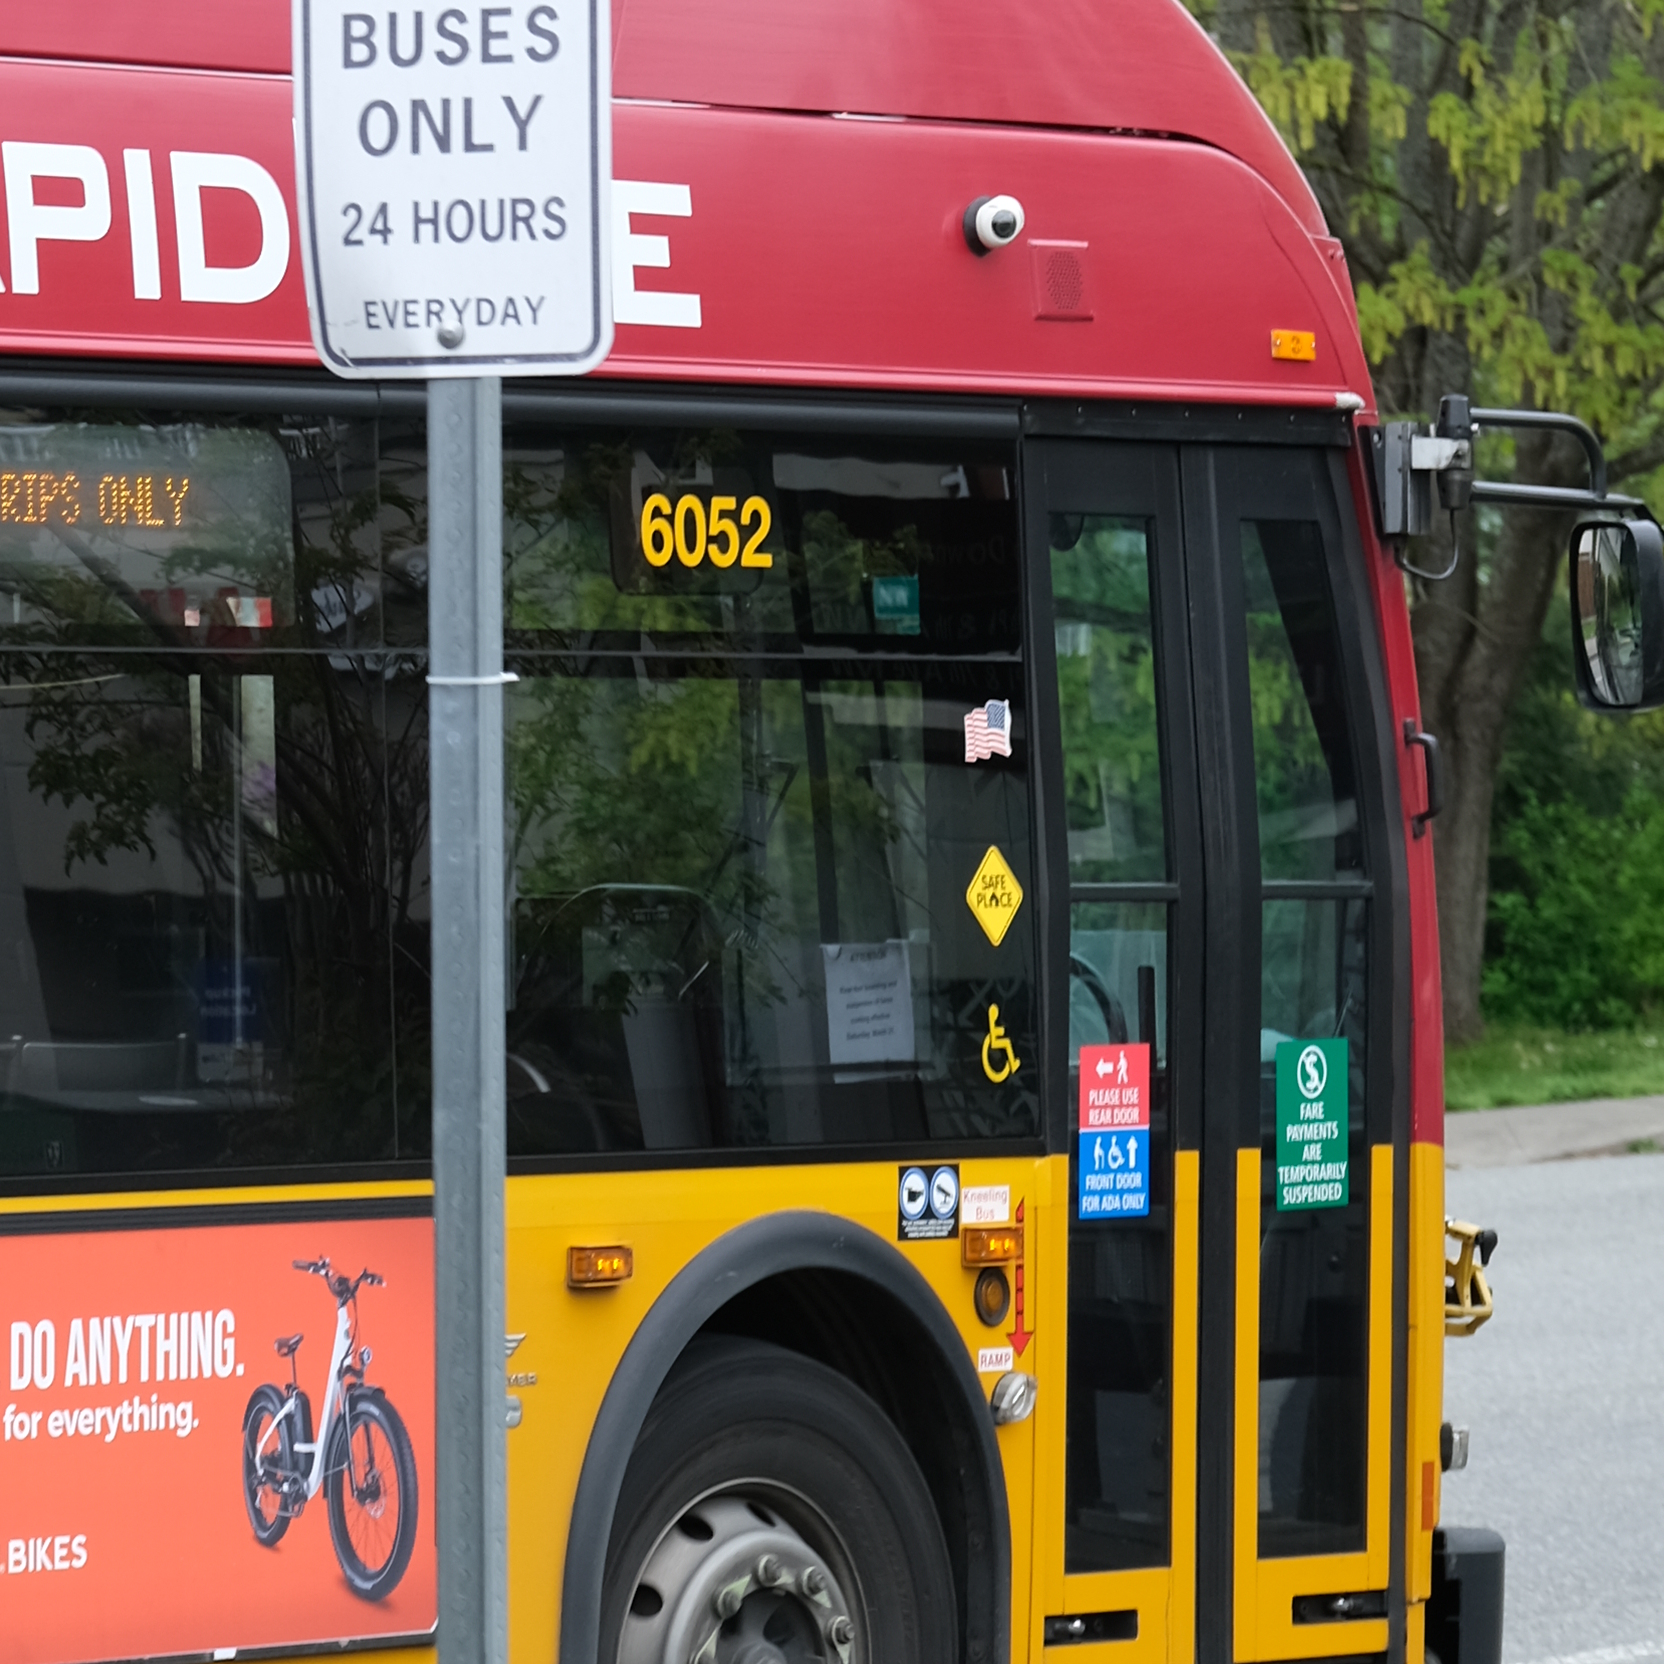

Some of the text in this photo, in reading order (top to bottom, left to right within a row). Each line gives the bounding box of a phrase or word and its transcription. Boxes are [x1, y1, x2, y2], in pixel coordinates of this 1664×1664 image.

[342, 5, 561, 70] BUSES
[358, 94, 545, 158] ONLY
[341, 196, 568, 247] 24 HOURS
[364, 295, 546, 331] EVERYDAY
[98, 474, 190, 527] ONLY
[640, 492, 773, 569] 6052
[981, 874, 1006, 891] SAFE
[1088, 1086, 1140, 1107] PLEASE USE
[1088, 1106, 1140, 1126] REAR DOOR
[1299, 1101, 1325, 1121] FARE
[1286, 1121, 1339, 1143] PAYMENTS
[1302, 1142, 1323, 1162] ARE
[1085, 1171, 1142, 1191] FRONT DOOR
[1277, 1161, 1348, 1185] TEMPORARILY
[963, 1187, 1008, 1205] Kneeling
[1082, 1192, 1146, 1213] FOR ADA ONLY
[1282, 1182, 1343, 1205] SUSPENDED
[975, 1207, 995, 1221] Bus
[9, 1318, 55, 1391] DO
[63, 1307, 245, 1388] ANYTHING.
[980, 1352, 1011, 1368] RAMP
[2, 1403, 44, 1443] for
[47, 1392, 200, 1444] everything.
[7, 1533, 88, 1575] BIKES
